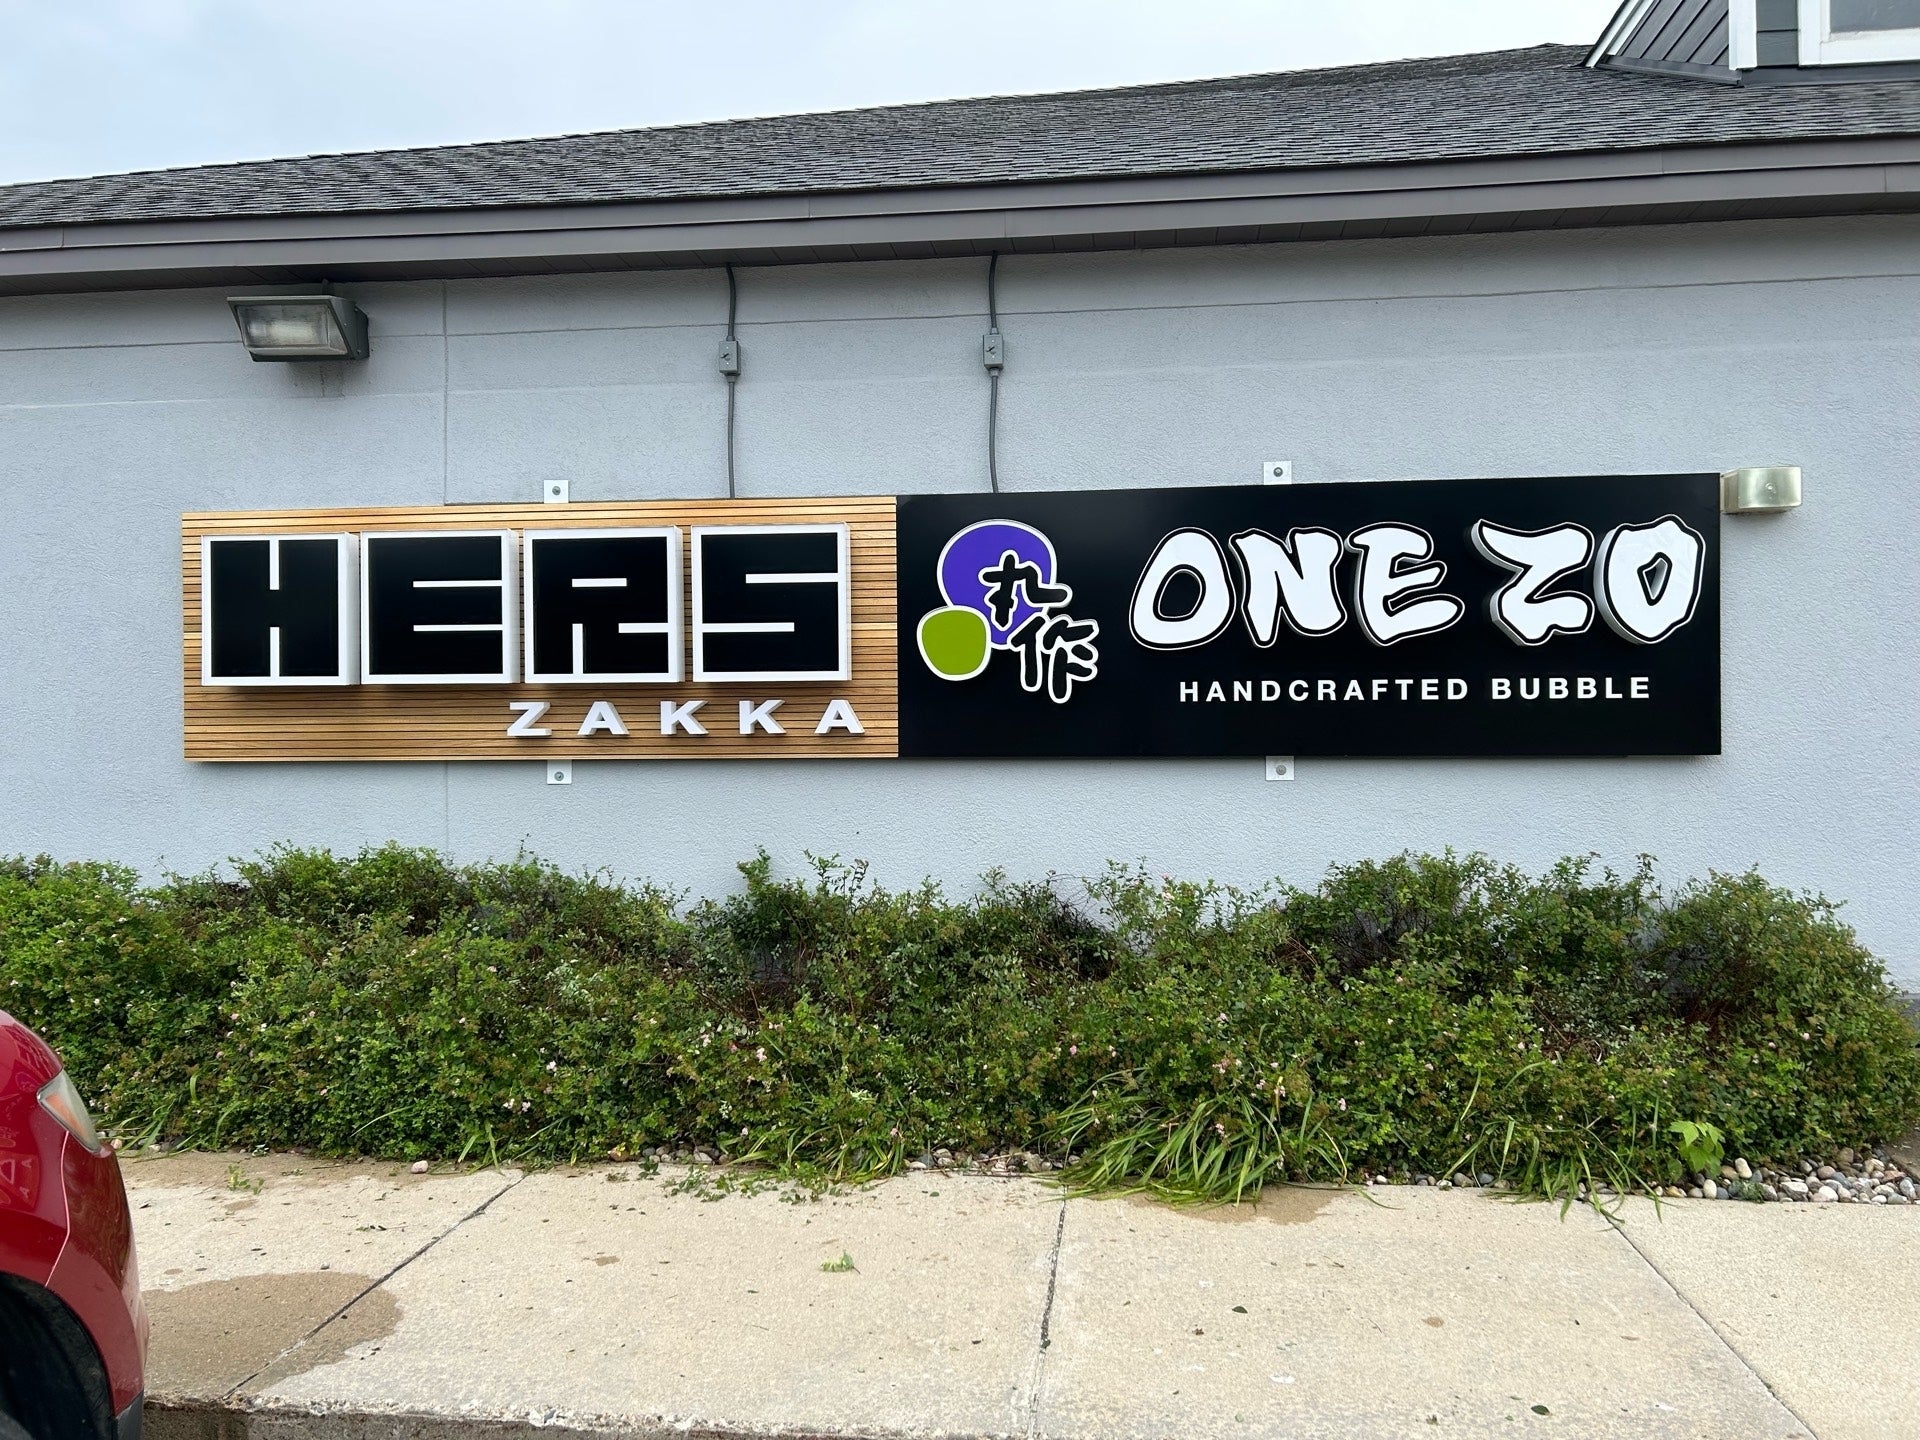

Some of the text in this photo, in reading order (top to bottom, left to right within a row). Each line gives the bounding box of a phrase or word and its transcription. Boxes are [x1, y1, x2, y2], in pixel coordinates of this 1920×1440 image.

[202, 524, 851, 686] HERS
[1179, 676, 1650, 702] HANDCRAFTED BUBBLE
[507, 699, 866, 737] ZAKKA
